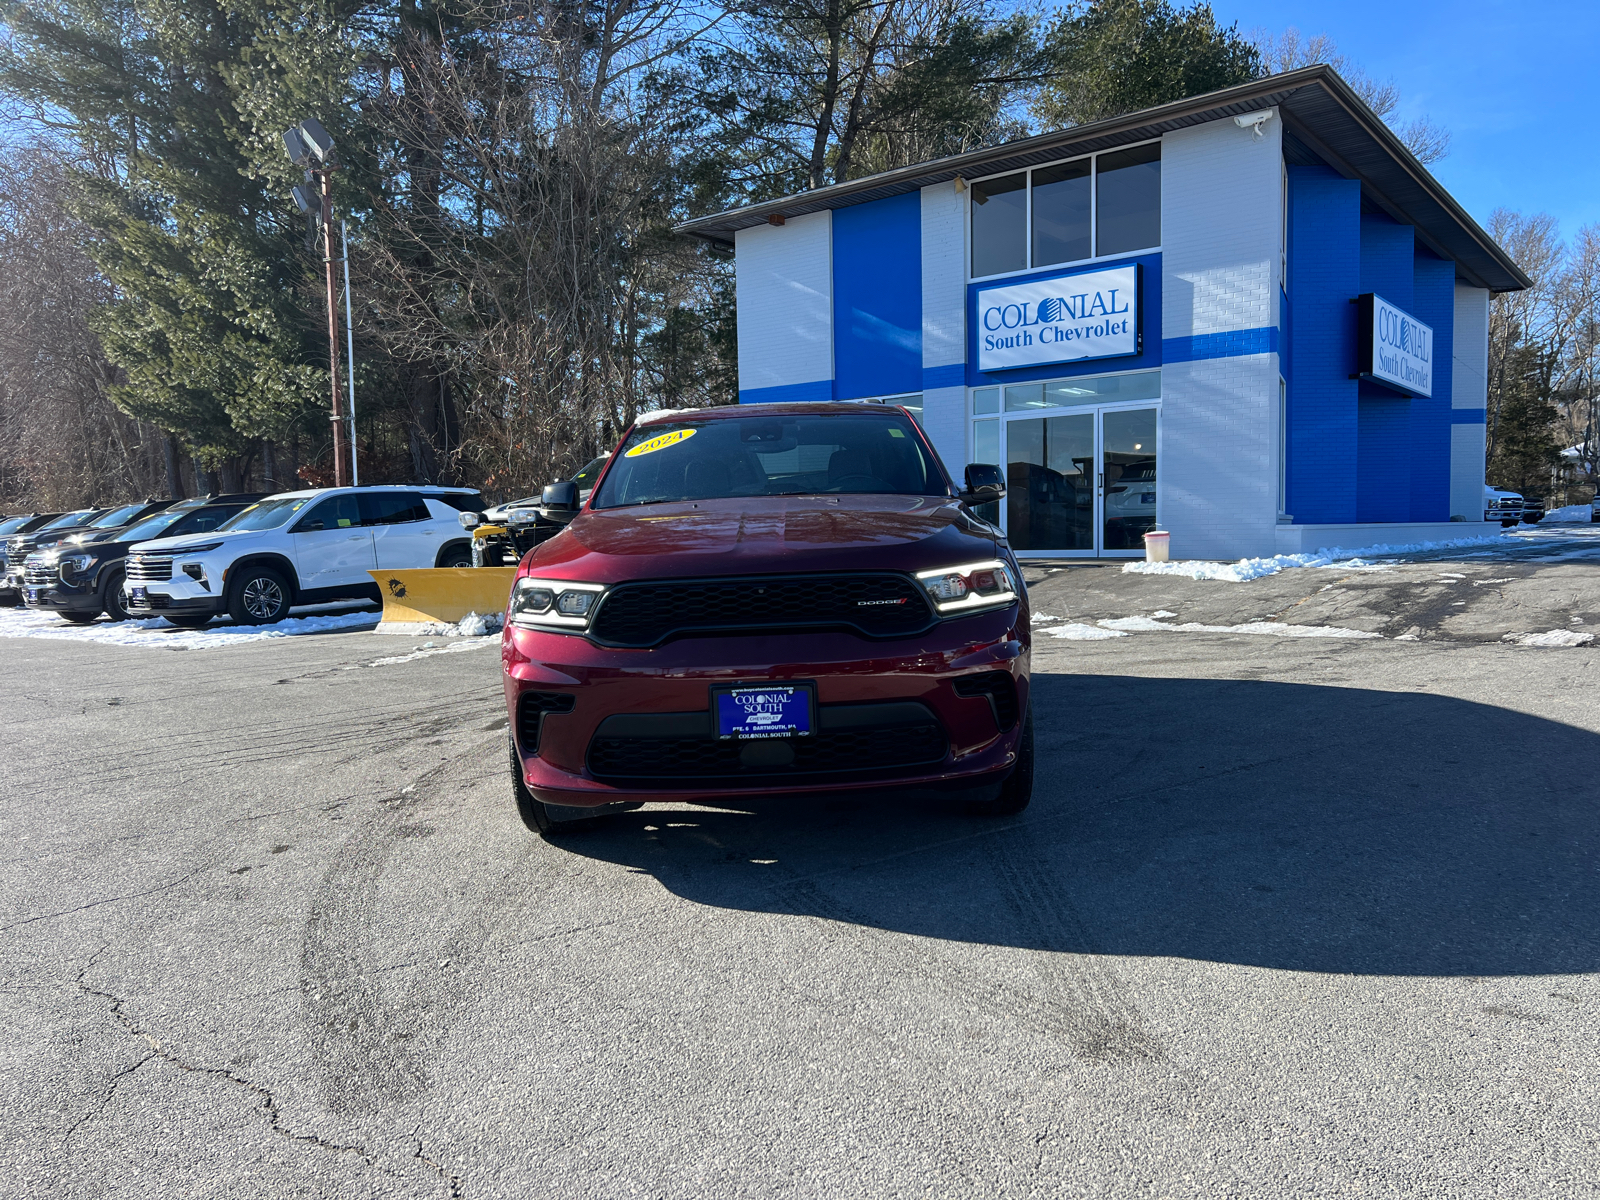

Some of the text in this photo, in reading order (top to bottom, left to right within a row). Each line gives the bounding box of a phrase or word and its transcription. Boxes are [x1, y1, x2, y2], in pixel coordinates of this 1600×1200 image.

[984, 289, 1129, 331] COLONIAL
[985, 318, 1129, 351] South Chevrolet
[1379, 306, 1429, 363] COLONIAL
[1379, 346, 1429, 389] South Chevrolet
[640, 431, 685, 453] 2024
[735, 694, 791, 705] COLONIAL
[744, 703, 783, 713] SOUTH
